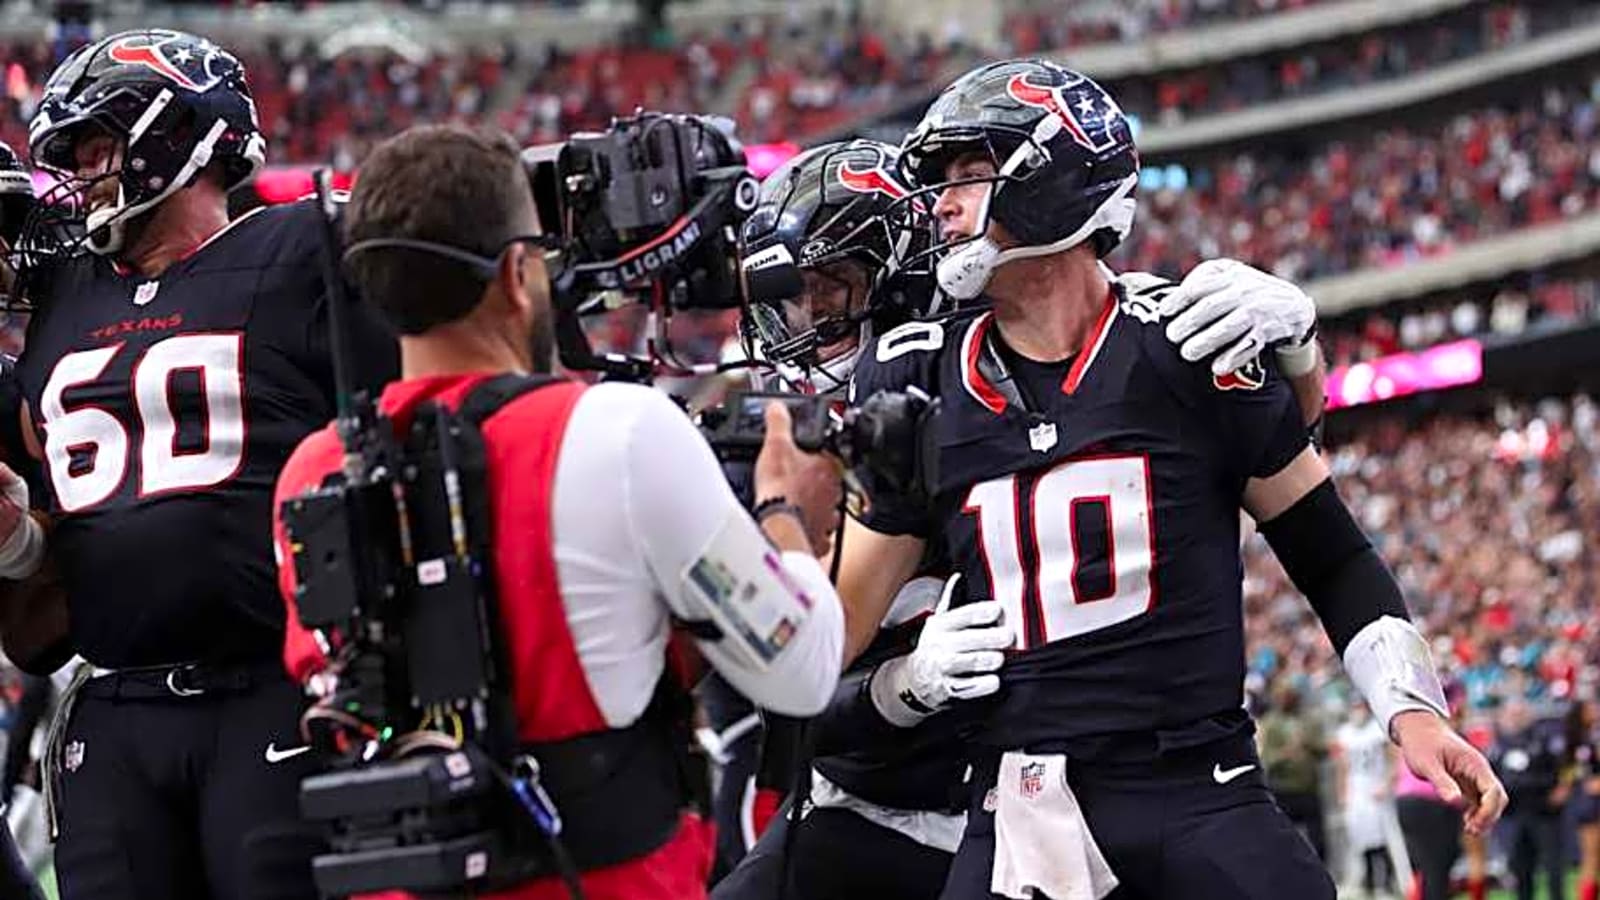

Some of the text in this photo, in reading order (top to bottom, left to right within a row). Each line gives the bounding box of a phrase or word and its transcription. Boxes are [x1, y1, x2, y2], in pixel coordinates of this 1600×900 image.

[90, 313, 183, 338] TEXANS
[40, 331, 244, 515] 60
[961, 451, 1156, 652] 10
[1023, 780, 1042, 795] NFL
